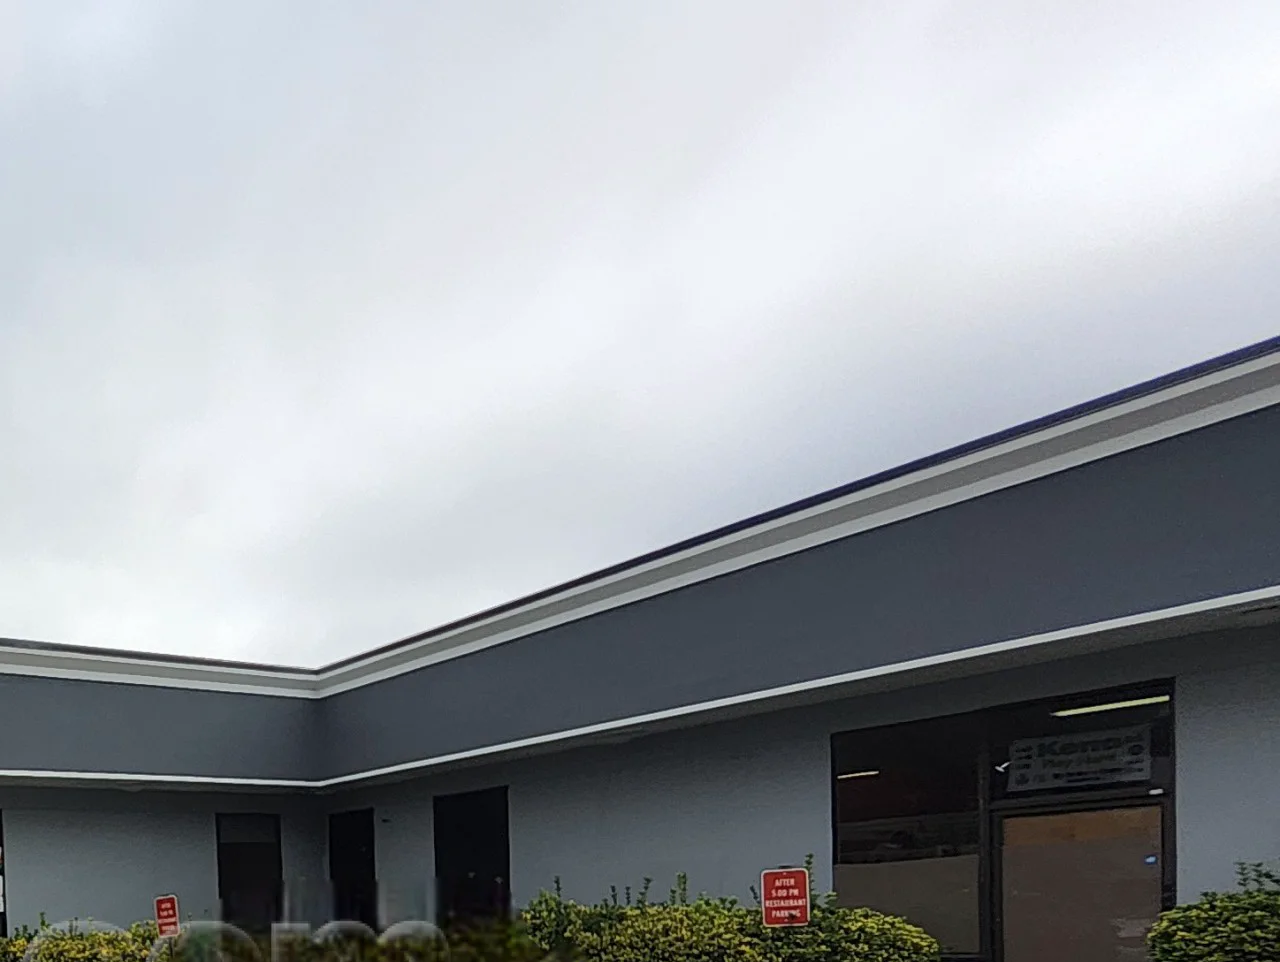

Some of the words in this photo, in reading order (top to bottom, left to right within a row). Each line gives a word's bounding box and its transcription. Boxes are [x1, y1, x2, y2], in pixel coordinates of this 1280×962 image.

[775, 878, 795, 887] AFTER
[789, 888, 799, 896] PM
[765, 899, 806, 907] RESTAURANT
